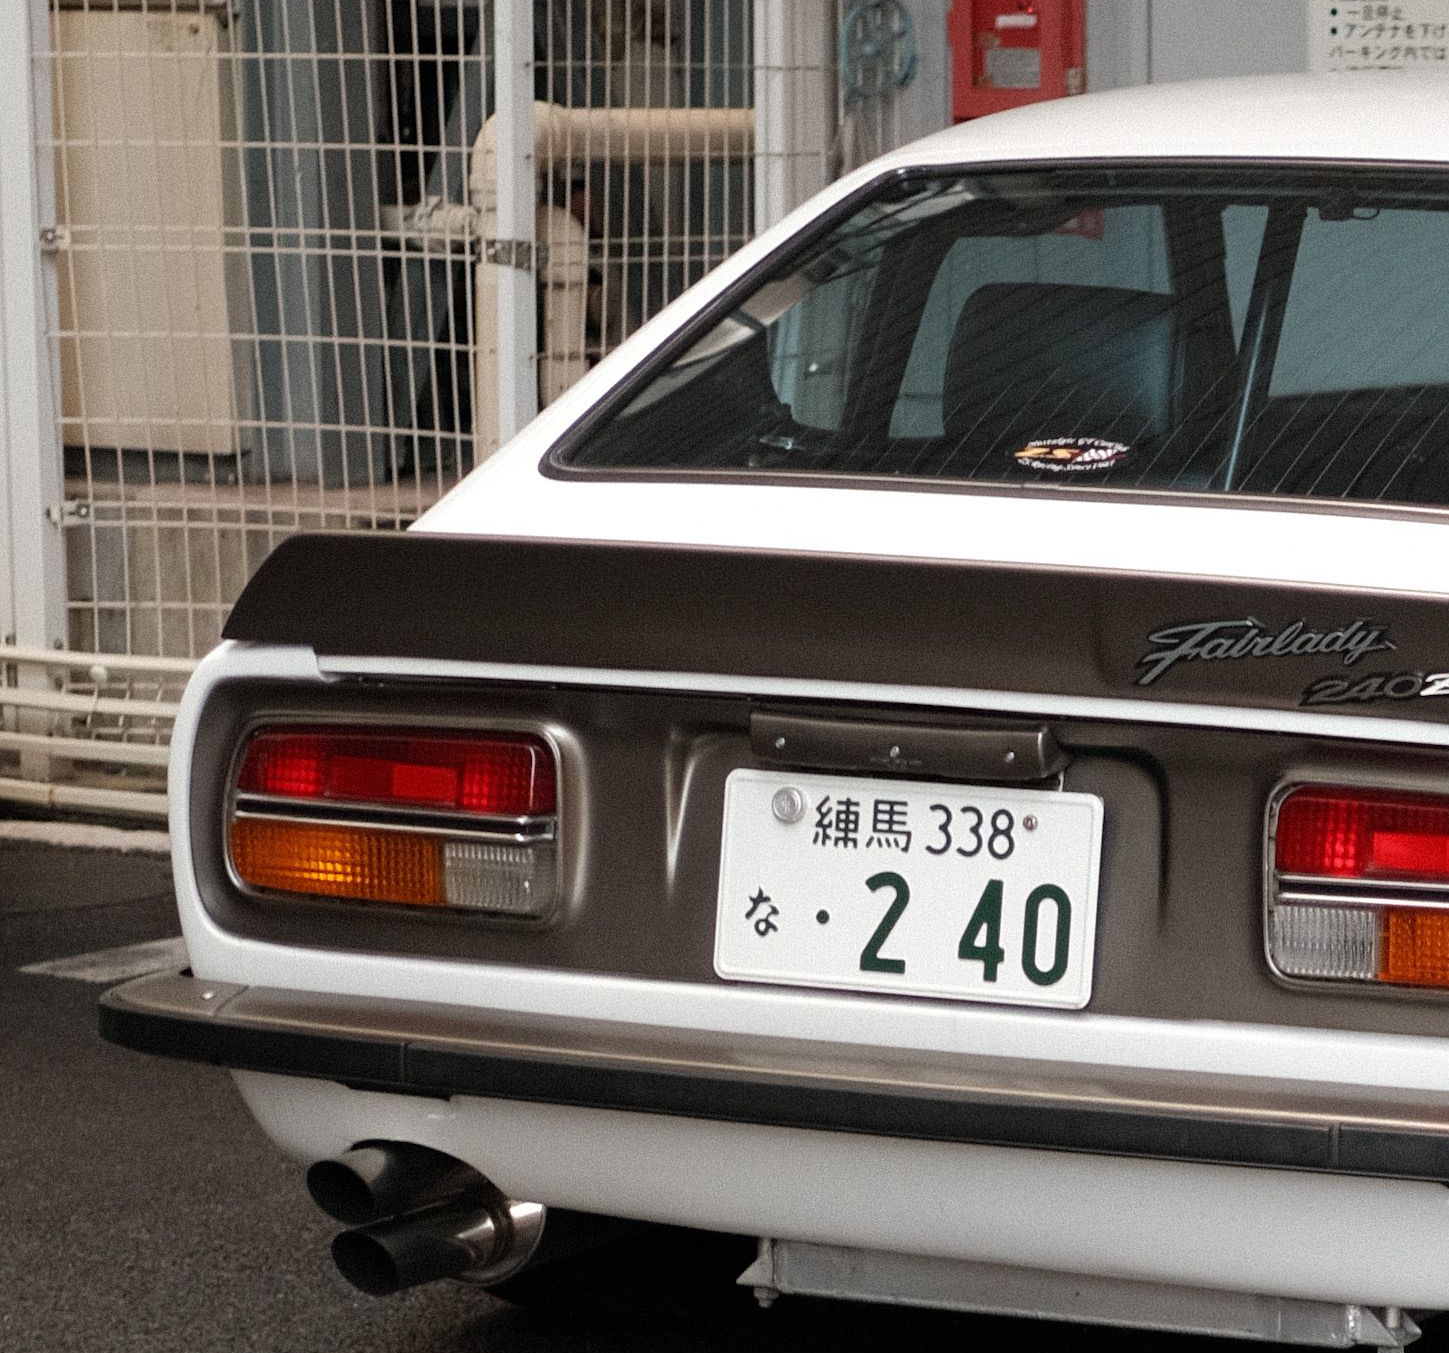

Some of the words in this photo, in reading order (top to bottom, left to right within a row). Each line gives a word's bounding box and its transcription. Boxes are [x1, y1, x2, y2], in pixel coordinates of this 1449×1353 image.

[1136, 617, 1397, 685] Fairlady
[812, 794, 912, 853] 練馬
[926, 803, 1015, 860] 338
[744, 885, 780, 937] な
